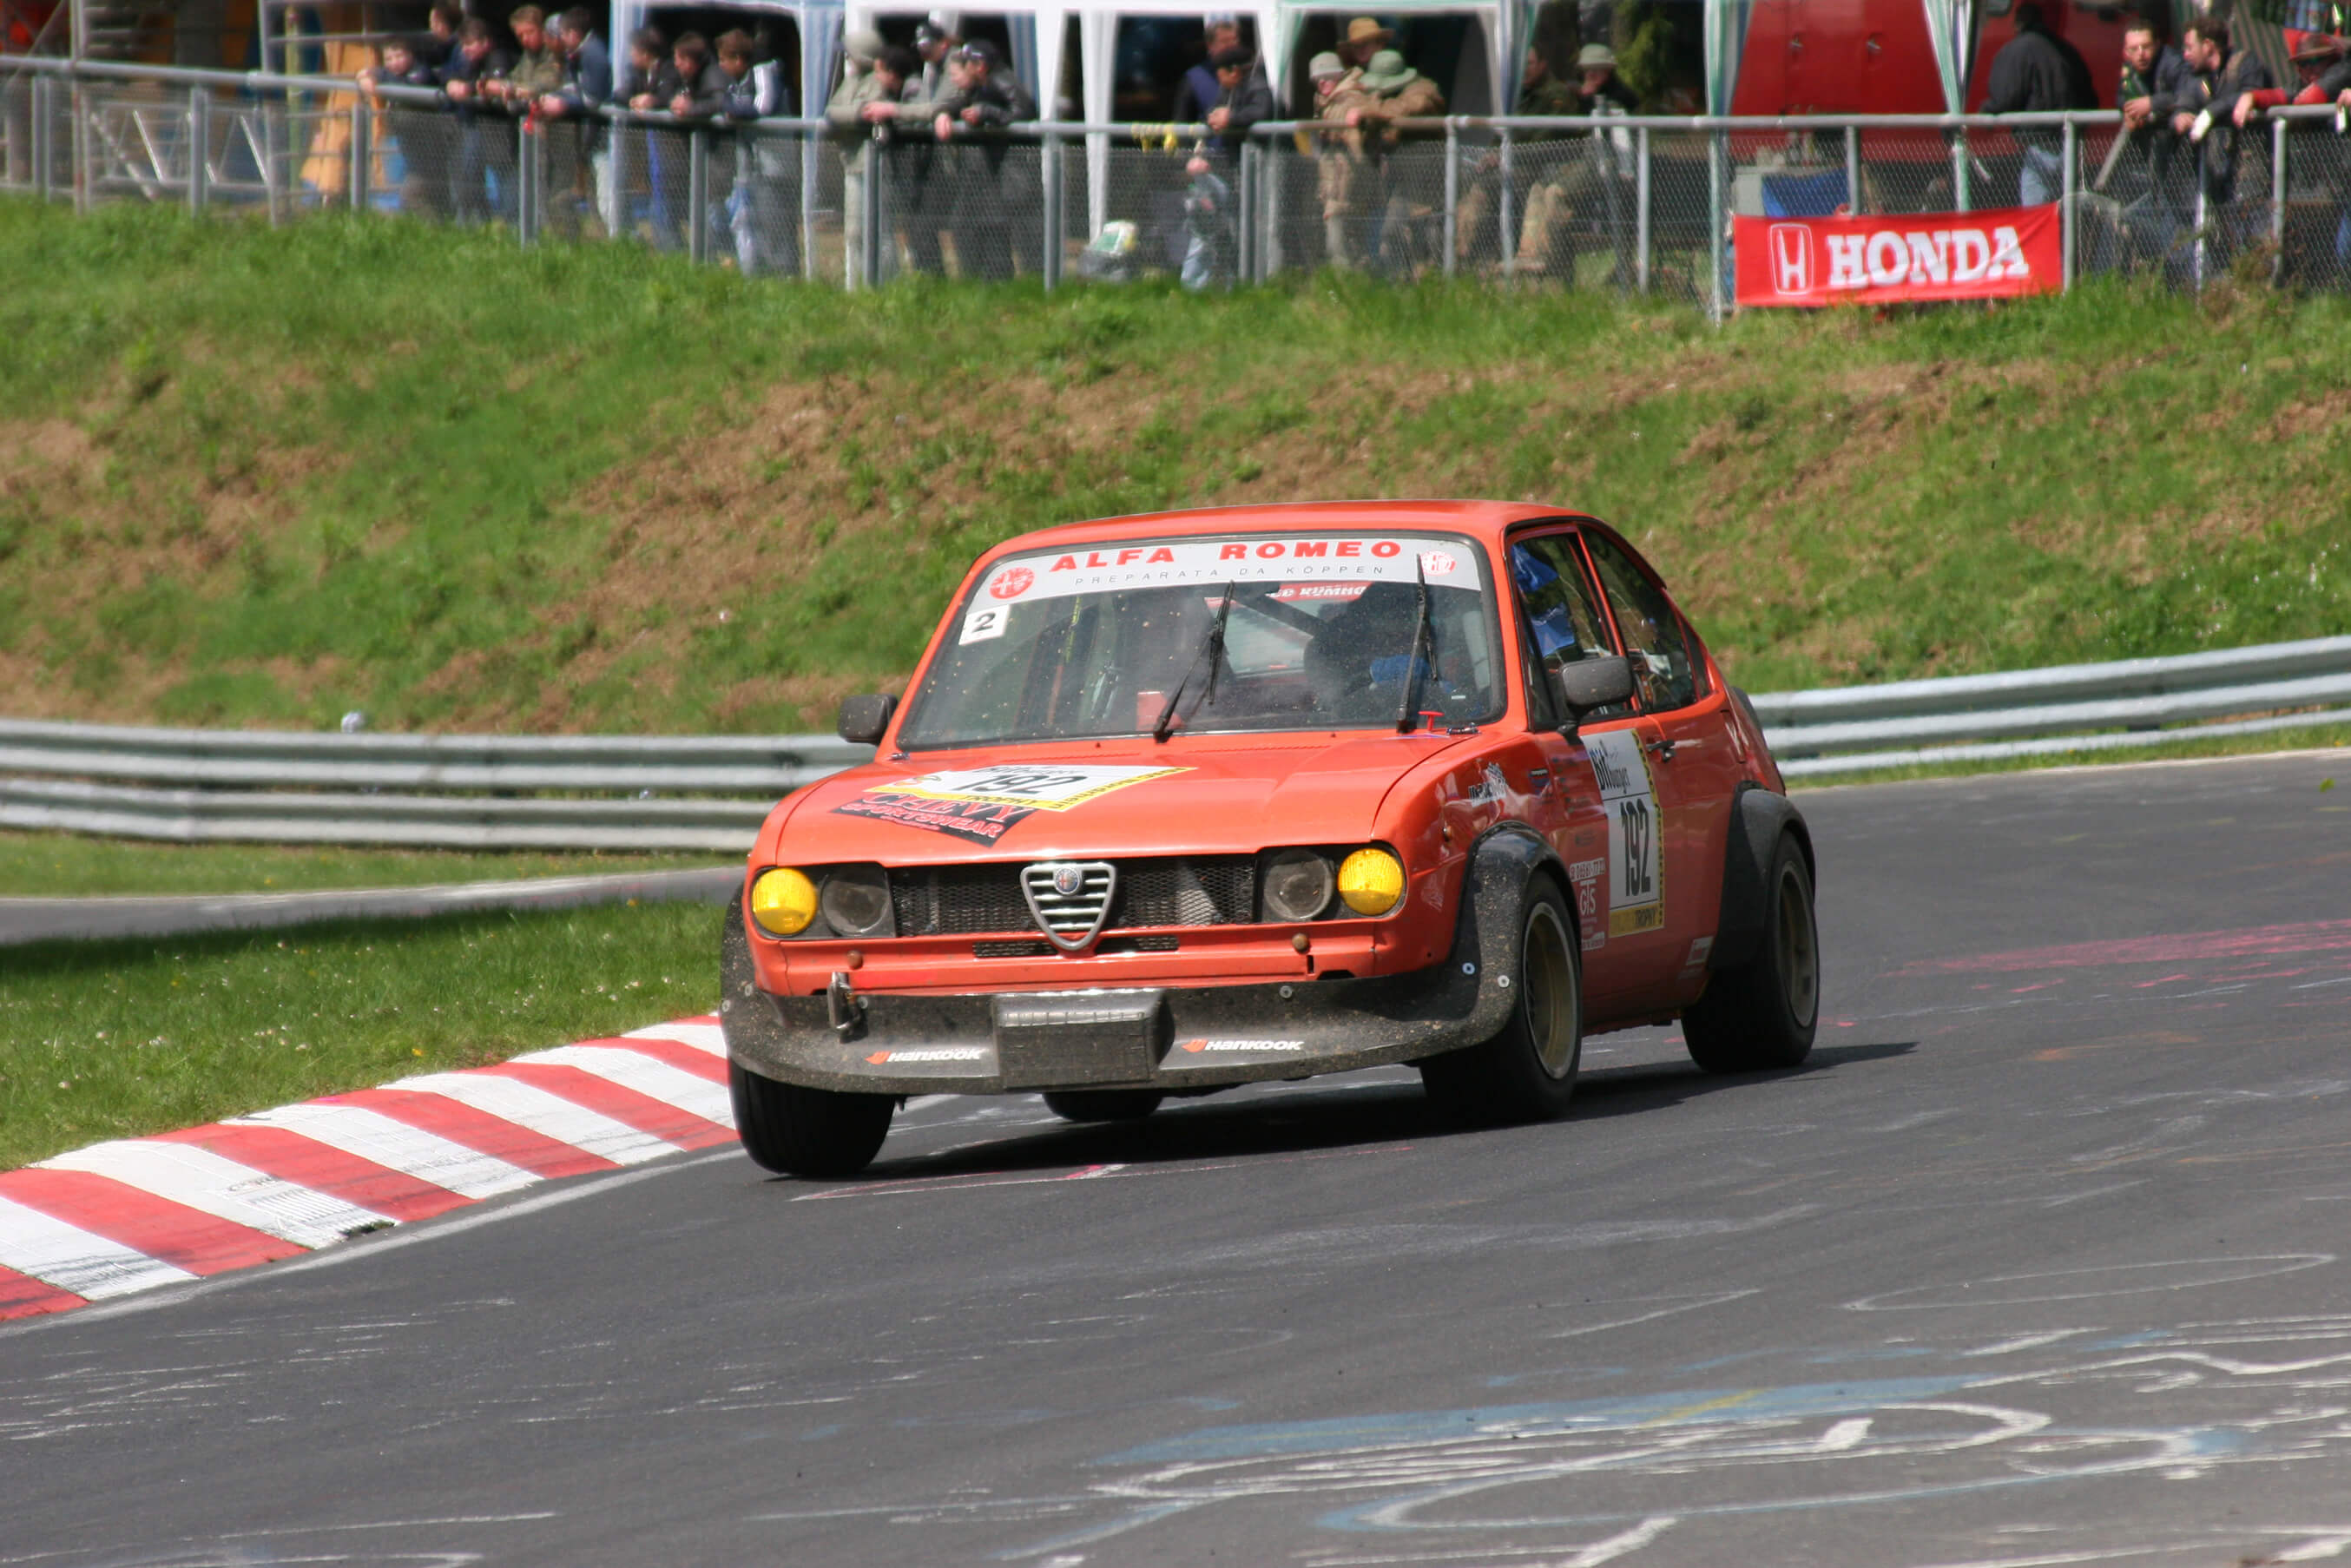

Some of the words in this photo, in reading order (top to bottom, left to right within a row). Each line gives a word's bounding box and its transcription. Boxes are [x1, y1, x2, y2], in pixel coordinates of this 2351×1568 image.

[1826, 226, 2030, 289] HONDA
[1049, 547, 1175, 572] ALFA
[1219, 541, 1401, 560] ROMEO
[1075, 567, 1218, 586] PREPARATA
[1286, 566, 1383, 576] KOPPEN
[972, 610, 996, 632] 2
[952, 774, 1089, 795] 192
[840, 803, 1004, 838] SPORTSWEAR
[863, 794, 1035, 823] CHEVY
[1620, 798, 1650, 897] 192
